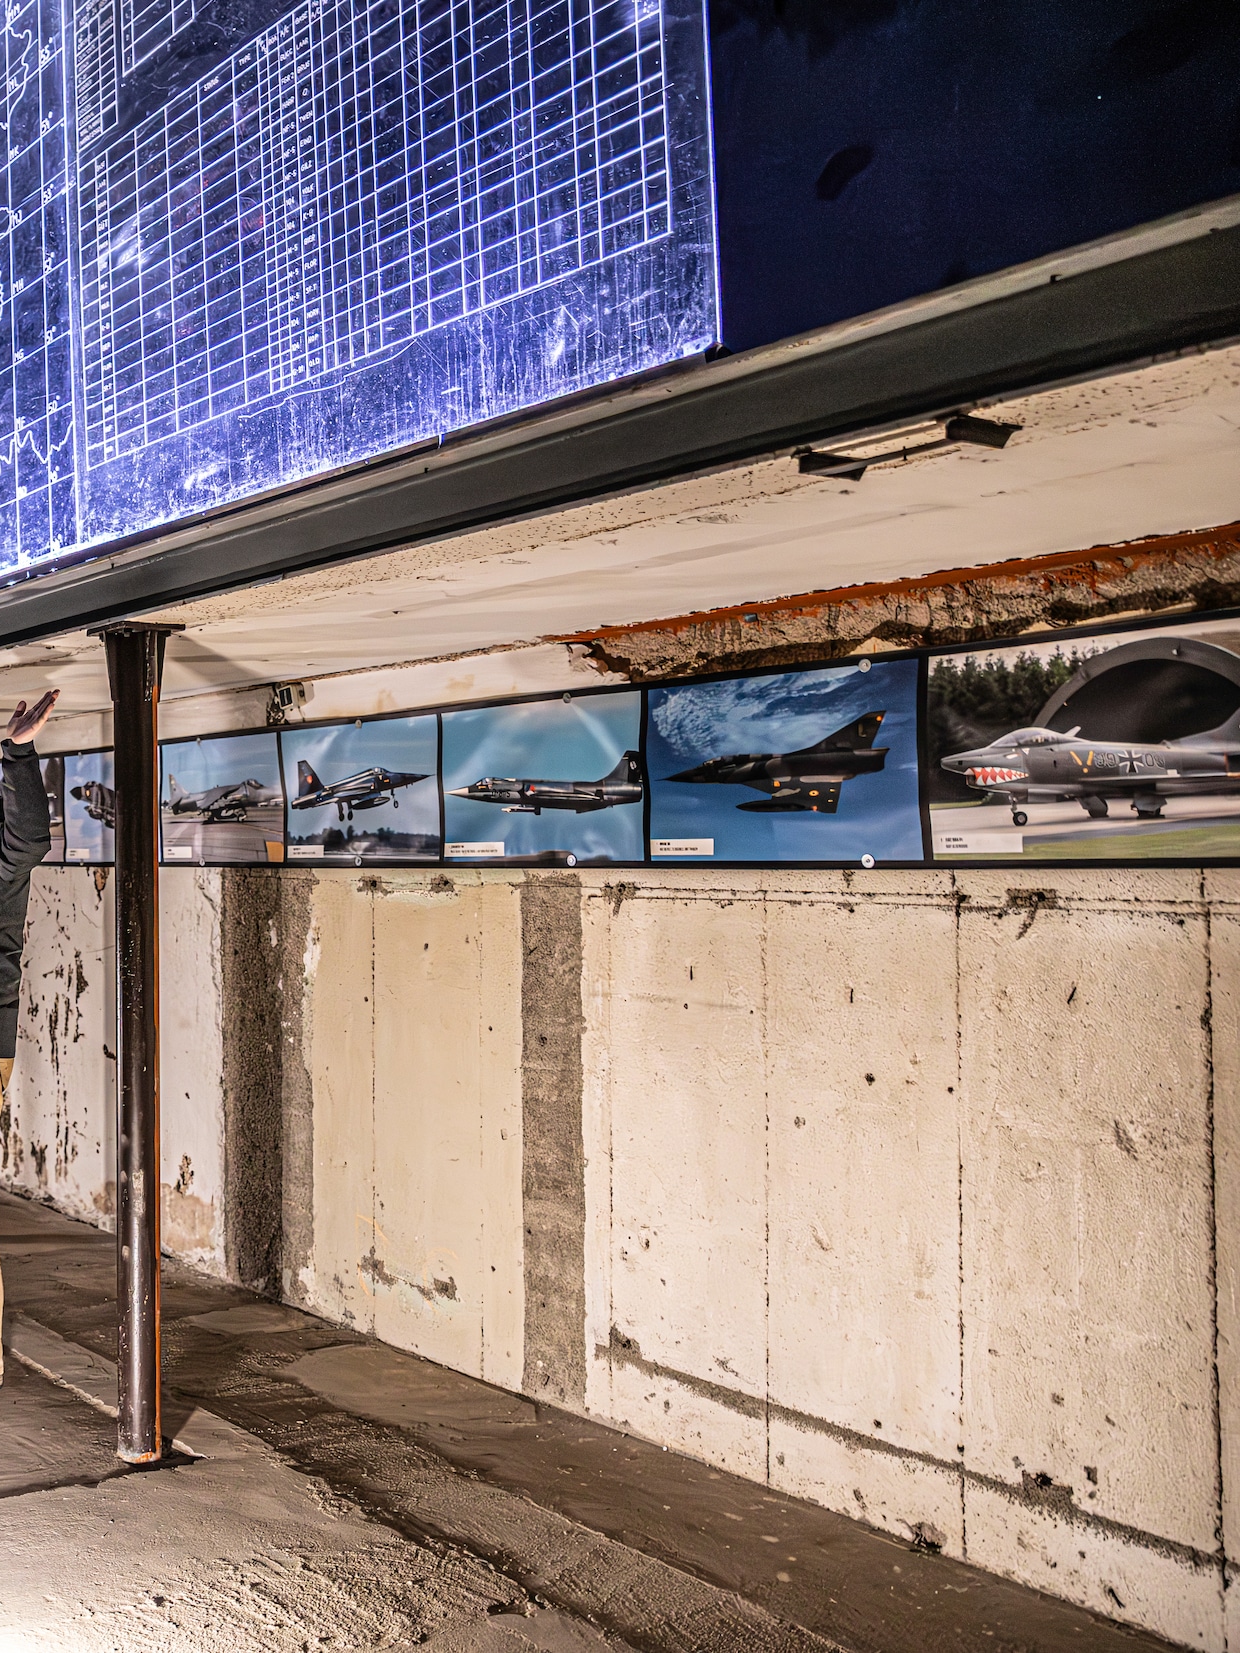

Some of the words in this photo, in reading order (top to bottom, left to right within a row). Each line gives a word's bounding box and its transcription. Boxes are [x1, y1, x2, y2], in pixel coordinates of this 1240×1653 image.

[40, 36, 53, 65] 55°
[295, 36, 309, 51] LAAR
[238, 53, 252, 66] TYPE
[42, 183, 54, 205] 53°
[304, 258, 318, 271] FLOR
[48, 394, 60, 413] 50°
